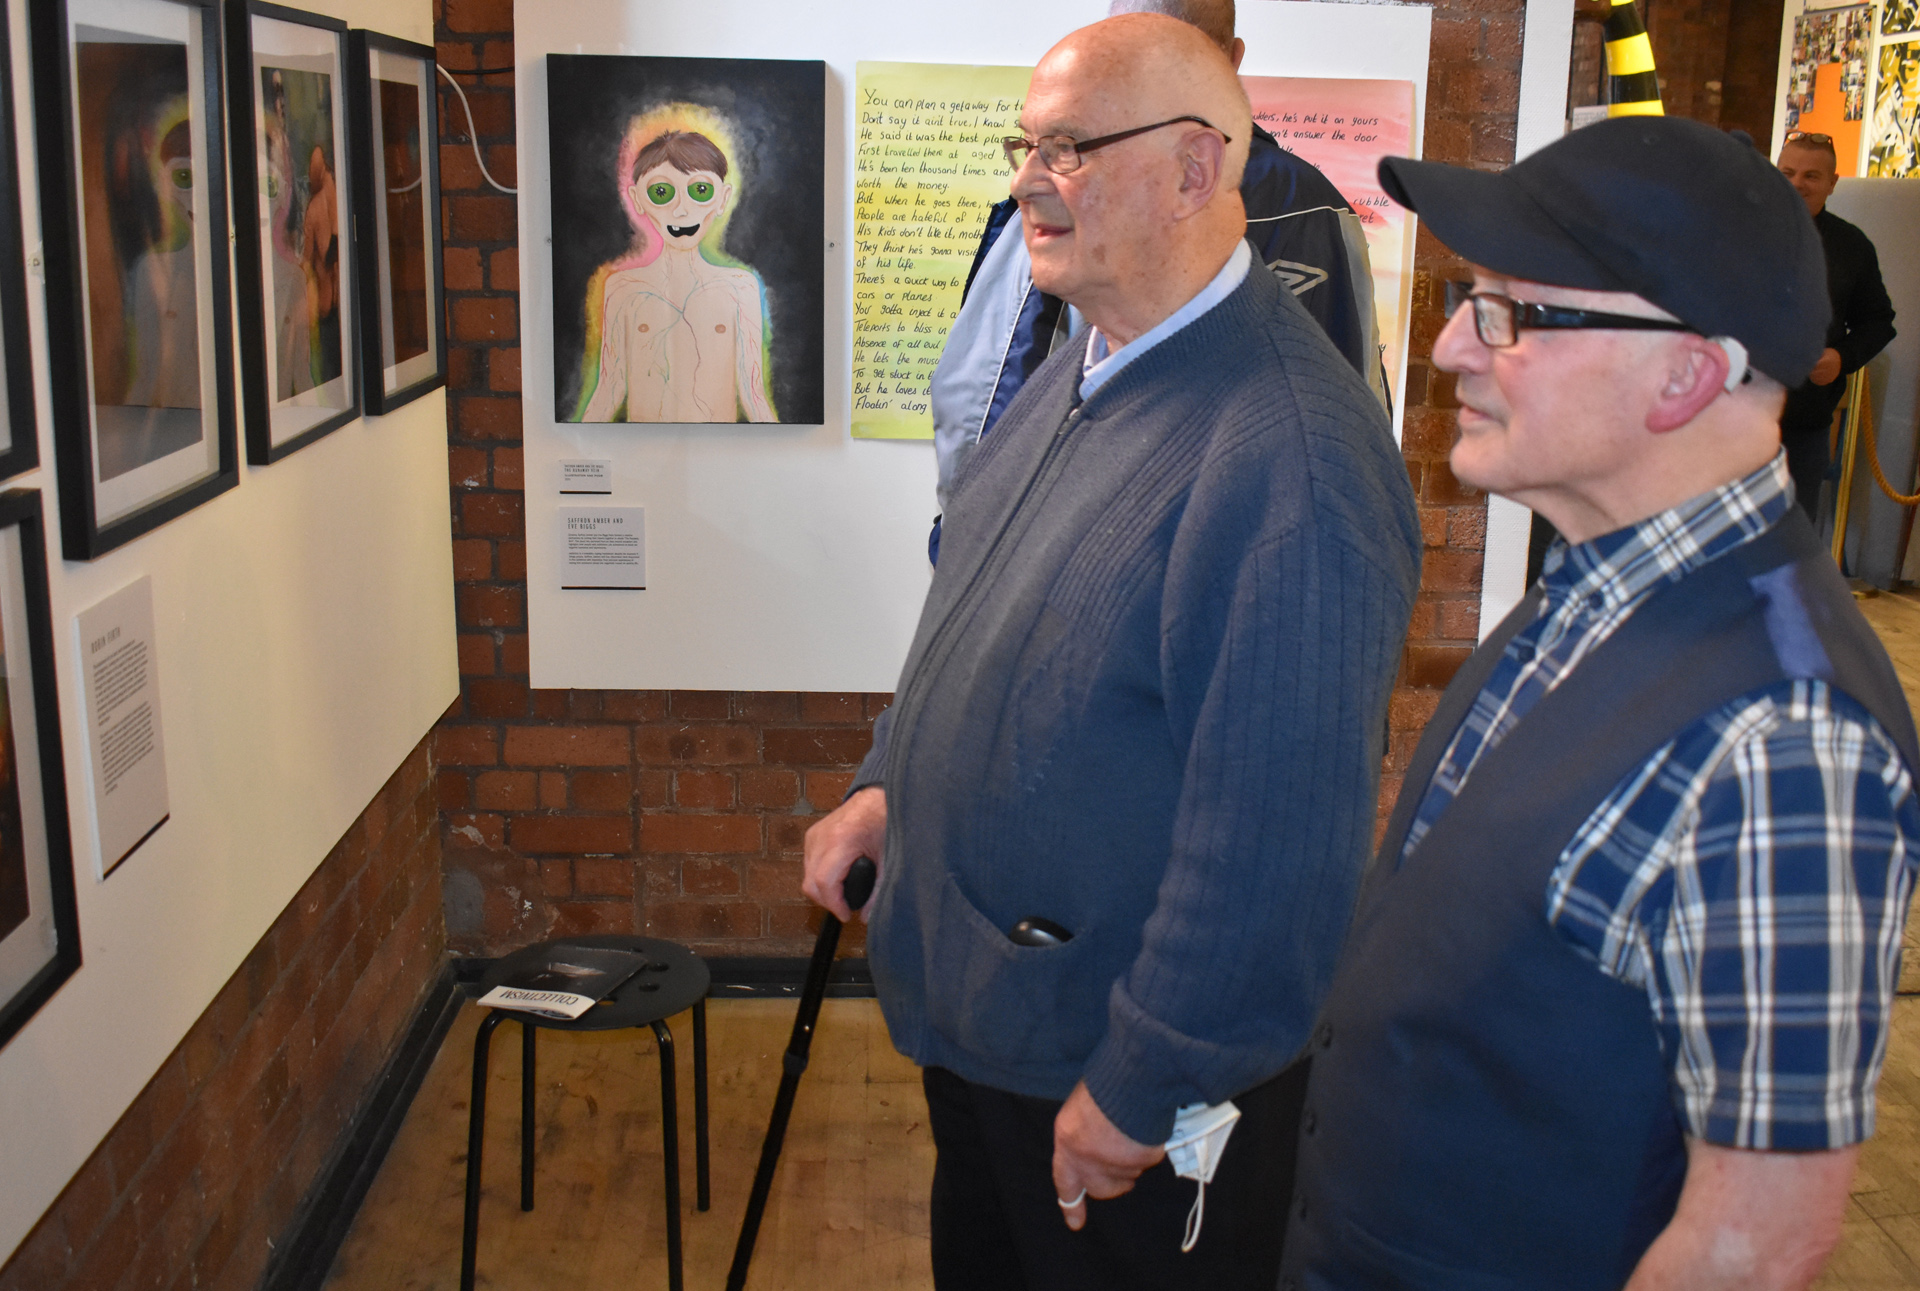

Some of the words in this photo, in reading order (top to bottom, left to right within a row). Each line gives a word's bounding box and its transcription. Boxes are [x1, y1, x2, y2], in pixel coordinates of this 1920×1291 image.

[864, 88, 888, 106] You
[894, 98, 913, 109] can
[915, 98, 936, 111] plan
[939, 101, 946, 110] a
[949, 100, 989, 114] getaway
[862, 111, 883, 125] Don't
[888, 115, 907, 130] say
[912, 114, 920, 125] it
[925, 114, 943, 126] ain't
[974, 116, 978, 128] I
[1282, 113, 1297, 123] he's
[1303, 114, 1317, 123] put
[1321, 114, 1328, 123] it
[1351, 117, 1378, 126] yours
[860, 127, 873, 140] He
[880, 130, 901, 140] said
[905, 130, 912, 141] it
[916, 134, 935, 142] was
[938, 130, 953, 142] the
[959, 132, 978, 143] best
[983, 133, 1005, 146] plac
[1293, 131, 1325, 139] answer
[1331, 130, 1345, 140] the
[1354, 130, 1378, 142] door
[858, 142, 880, 155] First
[885, 145, 921, 157] travelled
[949, 149, 958, 159] at
[971, 149, 995, 160] aged
[858, 159, 874, 172] He's
[880, 161, 897, 173] been
[901, 162, 914, 173] ten
[919, 161, 958, 174] thousand
[963, 164, 986, 176] times
[993, 166, 1011, 177] and
[895, 176, 907, 189] the
[856, 191, 873, 204] But
[914, 193, 926, 206] he
[933, 199, 950, 209] goes
[957, 196, 981, 209] there,
[1353, 198, 1389, 207] rubble
[856, 206, 885, 221] People
[892, 214, 906, 222] are
[911, 209, 948, 223] hateful
[955, 211, 967, 223] of
[857, 222, 871, 236] His
[900, 226, 923, 238] don't
[926, 225, 941, 239] like
[944, 226, 955, 240] it,
[855, 240, 878, 255] They
[908, 244, 923, 254] he's
[931, 246, 952, 256] gonna
[856, 256, 866, 268] of
[876, 256, 891, 268] his
[855, 272, 885, 284] There's
[932, 279, 947, 290] way
[950, 277, 959, 287] to
[856, 291, 875, 299] cars
[884, 292, 895, 300] or
[855, 302, 872, 315] You
[880, 303, 903, 315] gotta
[909, 306, 931, 318] inject
[937, 309, 944, 318] it
[854, 318, 890, 333] Teleports
[897, 321, 905, 332] to
[914, 321, 932, 334] bliss
[938, 326, 947, 335] in
[854, 336, 887, 348] Absence
[892, 339, 904, 349] of
[907, 339, 922, 349] all
[854, 350, 865, 363] He
[873, 350, 889, 364] lets
[897, 351, 910, 365] the
[853, 367, 866, 378] To
[873, 369, 885, 379] get
[890, 369, 912, 380] stuck
[854, 382, 870, 394] But
[876, 381, 888, 394] he
[895, 382, 916, 395] loves
[855, 395, 893, 410] Floatin'
[900, 401, 927, 415] along
[499, 989, 579, 1005] COLLECTIVISM
